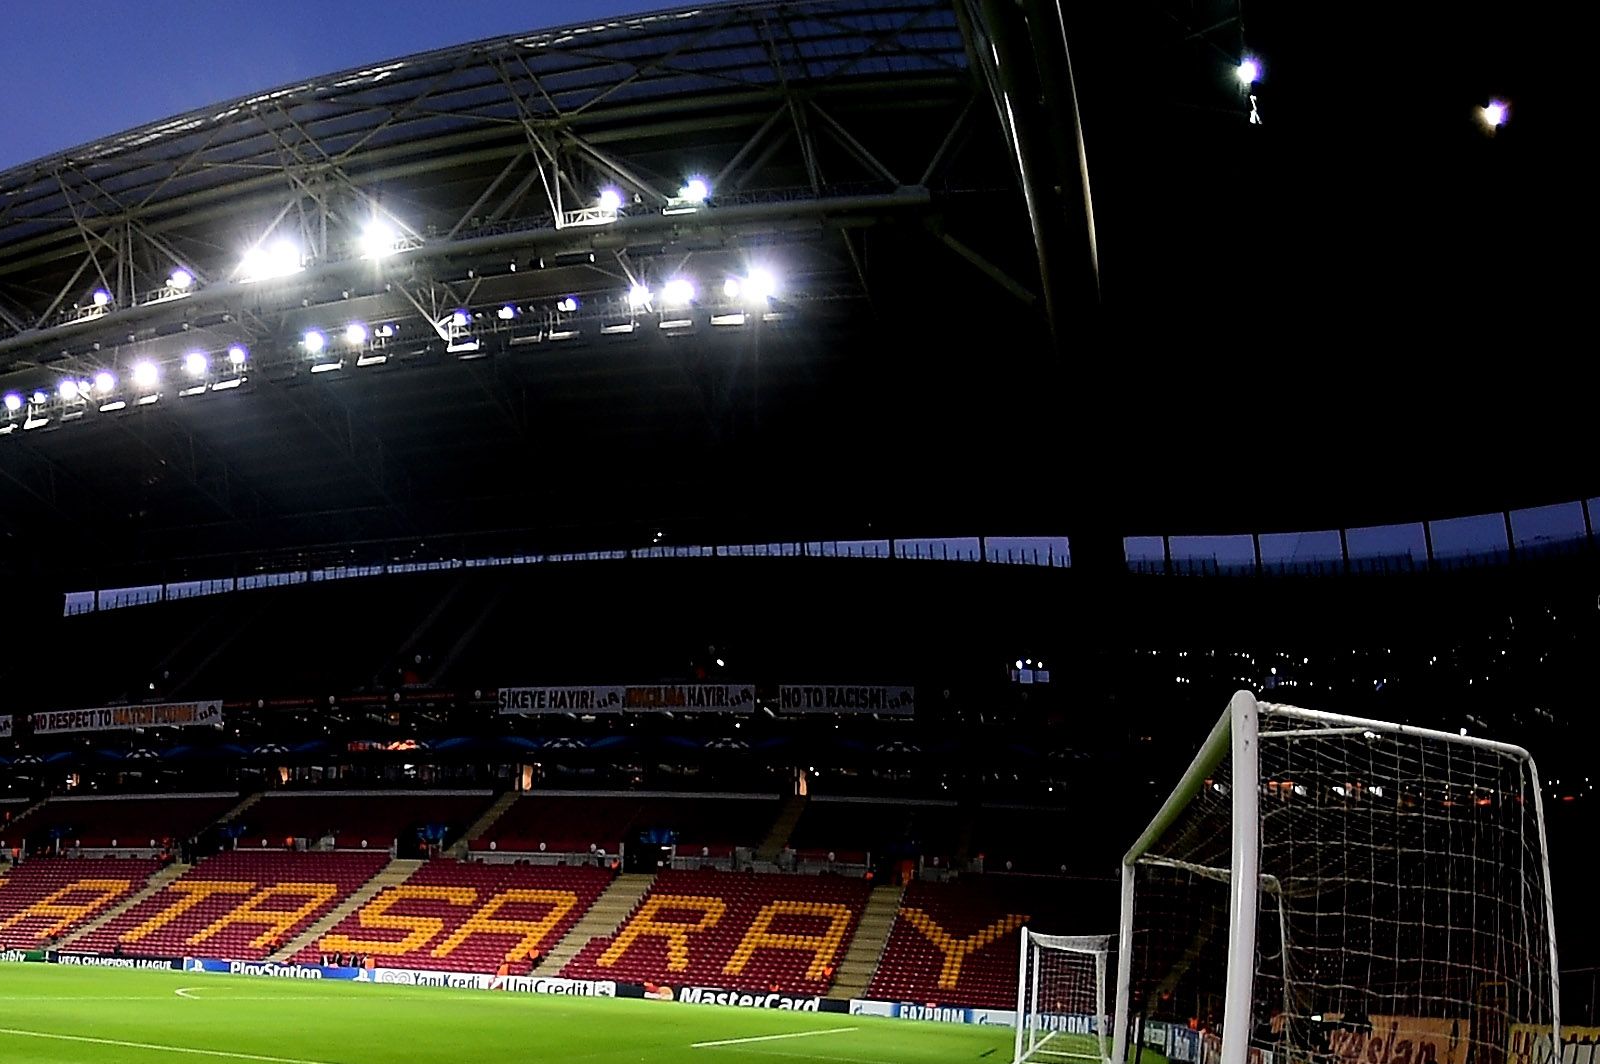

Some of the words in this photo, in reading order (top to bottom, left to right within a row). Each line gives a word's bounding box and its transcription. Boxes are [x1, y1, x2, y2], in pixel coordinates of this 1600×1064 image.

[549, 690, 595, 709] HAYIR!
[688, 686, 729, 707] HAYIR!
[780, 687, 802, 708] NO
[804, 687, 824, 708] TO
[33, 713, 48, 730] NO
[49, 709, 94, 729] RESPECT
[99, 708, 112, 726] TO
[58, 955, 80, 966] UEFA
[82, 956, 134, 968] CHAMPIONS
[136, 959, 172, 970] LEAGUE
[230, 961, 322, 979] PlayStation
[506, 978, 589, 997] UniCredit
[679, 987, 821, 1013] MasterCard
[900, 1004, 966, 1024] GAZPROM
[1025, 1013, 1090, 1035] GZPROM
